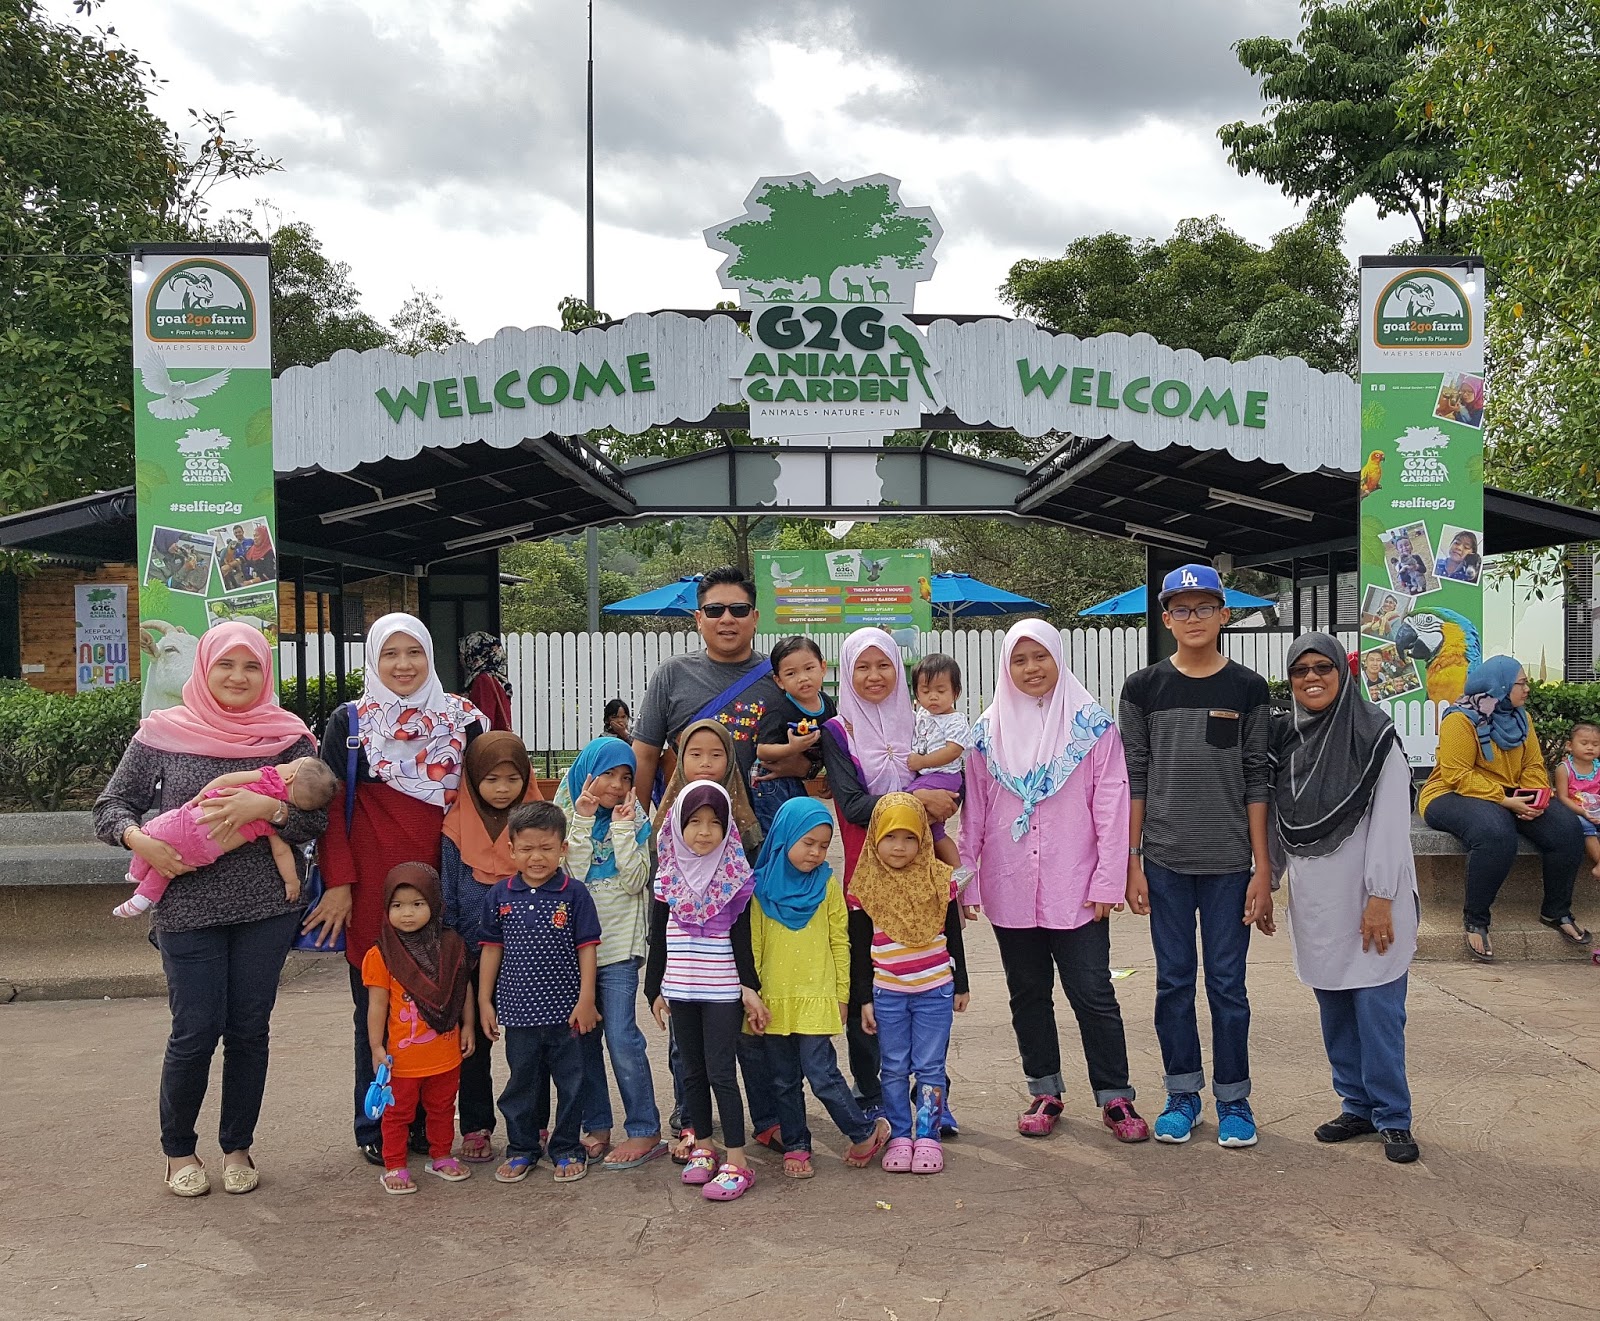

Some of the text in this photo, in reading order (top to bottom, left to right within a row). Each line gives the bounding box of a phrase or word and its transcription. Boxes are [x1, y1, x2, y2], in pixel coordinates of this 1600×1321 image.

[156, 313, 246, 326] goat2gofarm
[1383, 321, 1463, 334] goat2gofarm
[757, 306, 885, 351] G2G
[745, 353, 910, 377] ANIMAL
[375, 352, 656, 424] WELCOME
[747, 378, 908, 402] GARDEN
[1016, 358, 1268, 428] WELCOME
[185, 458, 219, 469] G2G
[1404, 458, 1437, 469] G2G
[170, 501, 242, 514] #selfieg2g
[1391, 497, 1455, 510] #selfieg2g
[1181, 569, 1198, 586] LA
[79, 643, 126, 664] NOW
[79, 666, 126, 684] OPEN
